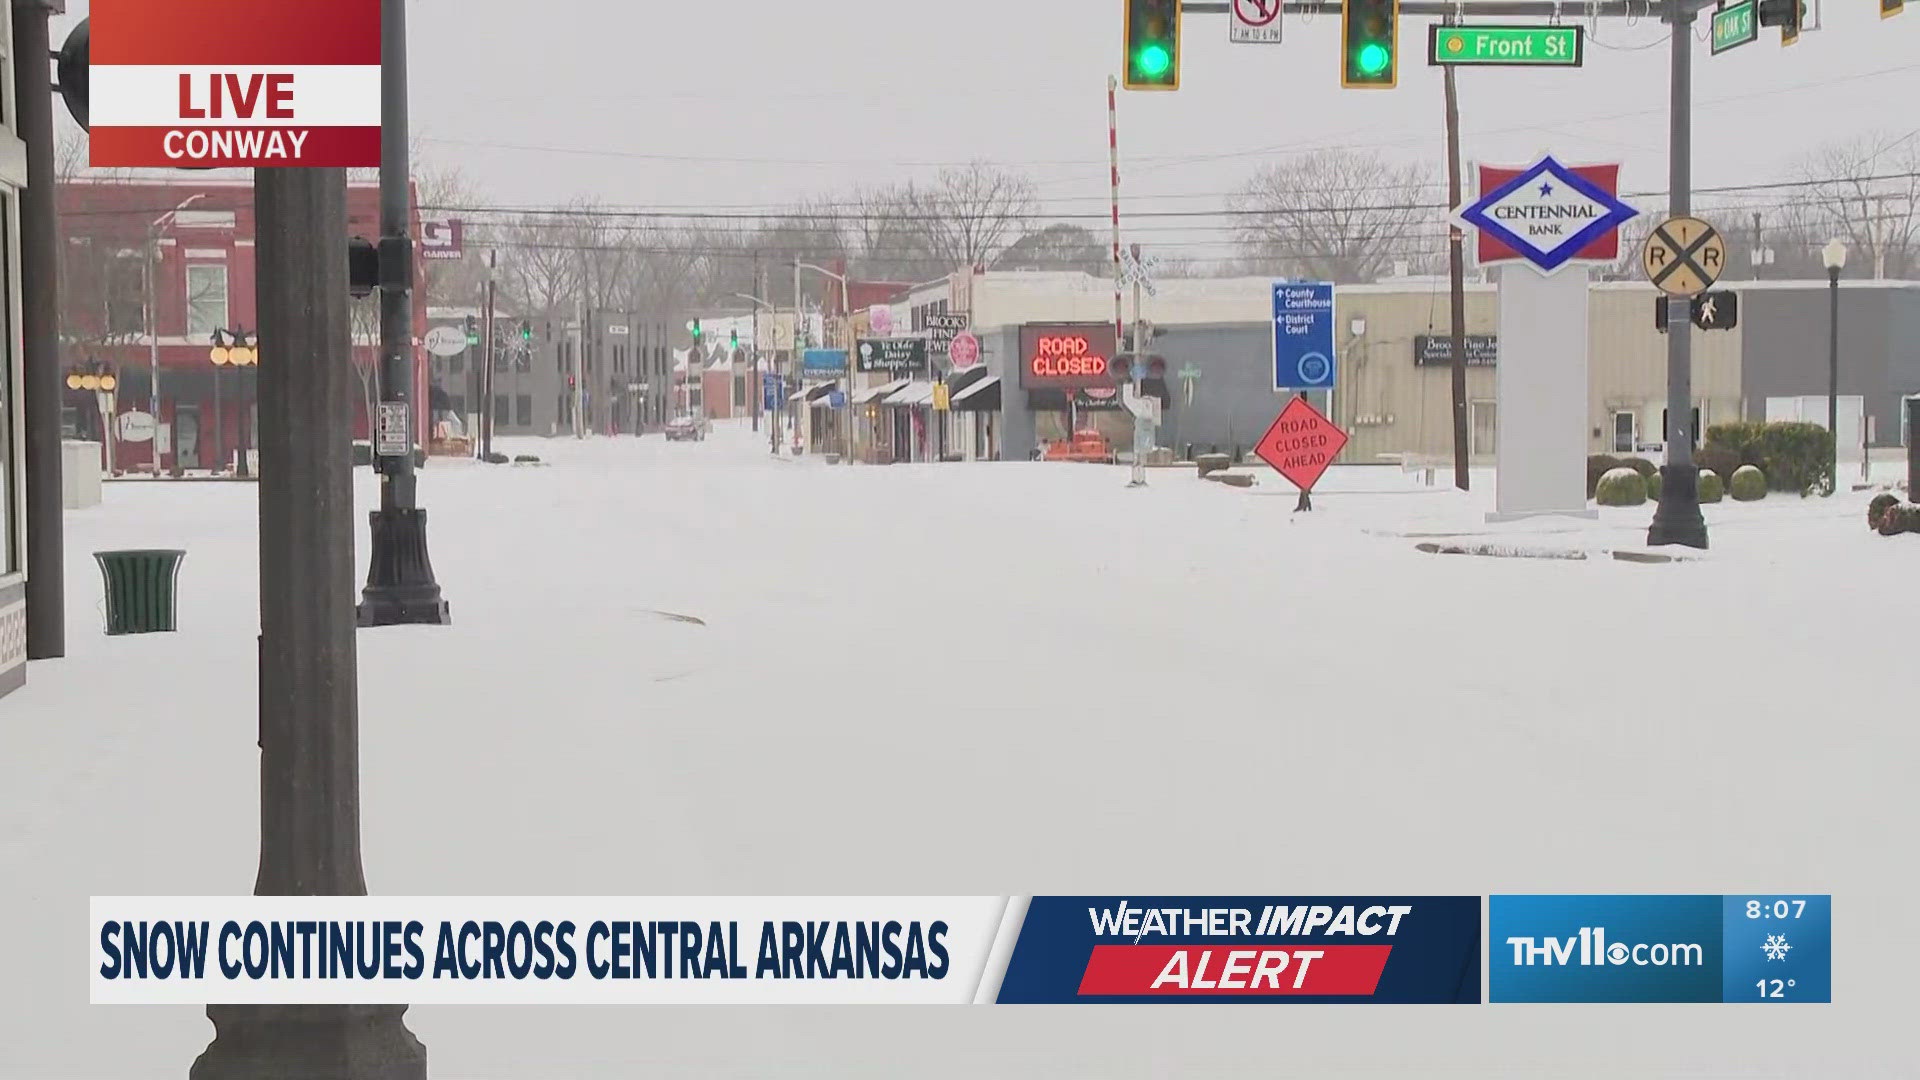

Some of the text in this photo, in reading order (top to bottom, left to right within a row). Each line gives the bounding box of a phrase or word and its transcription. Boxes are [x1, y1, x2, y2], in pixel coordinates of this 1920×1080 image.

[1241, 28, 1249, 39] AM
[1253, 28, 1260, 40] TO
[1269, 28, 1279, 40] PM
[1724, 16, 1740, 40] OAK
[1476, 34, 1566, 57] Front St
[1494, 204, 1597, 219] CENTENNIAL
[1528, 224, 1563, 235] BANK
[423, 250, 461, 259] GARVER
[1650, 246, 1719, 266] R R
[1285, 289, 1315, 299] County
[1285, 298, 1331, 308] Courthouse
[926, 315, 966, 328] BROOKS
[1285, 314, 1315, 324] District
[1285, 324, 1308, 334] Court
[892, 340, 914, 350] Olde
[1038, 337, 1088, 356] ROAD
[1427, 338, 1452, 349] Broo
[885, 350, 911, 361] Daisy
[1032, 356, 1106, 375] CLOSED
[1280, 418, 1318, 434] ROAD
[1275, 434, 1327, 453] CLOSED
[1283, 452, 1326, 469] AHEAD
